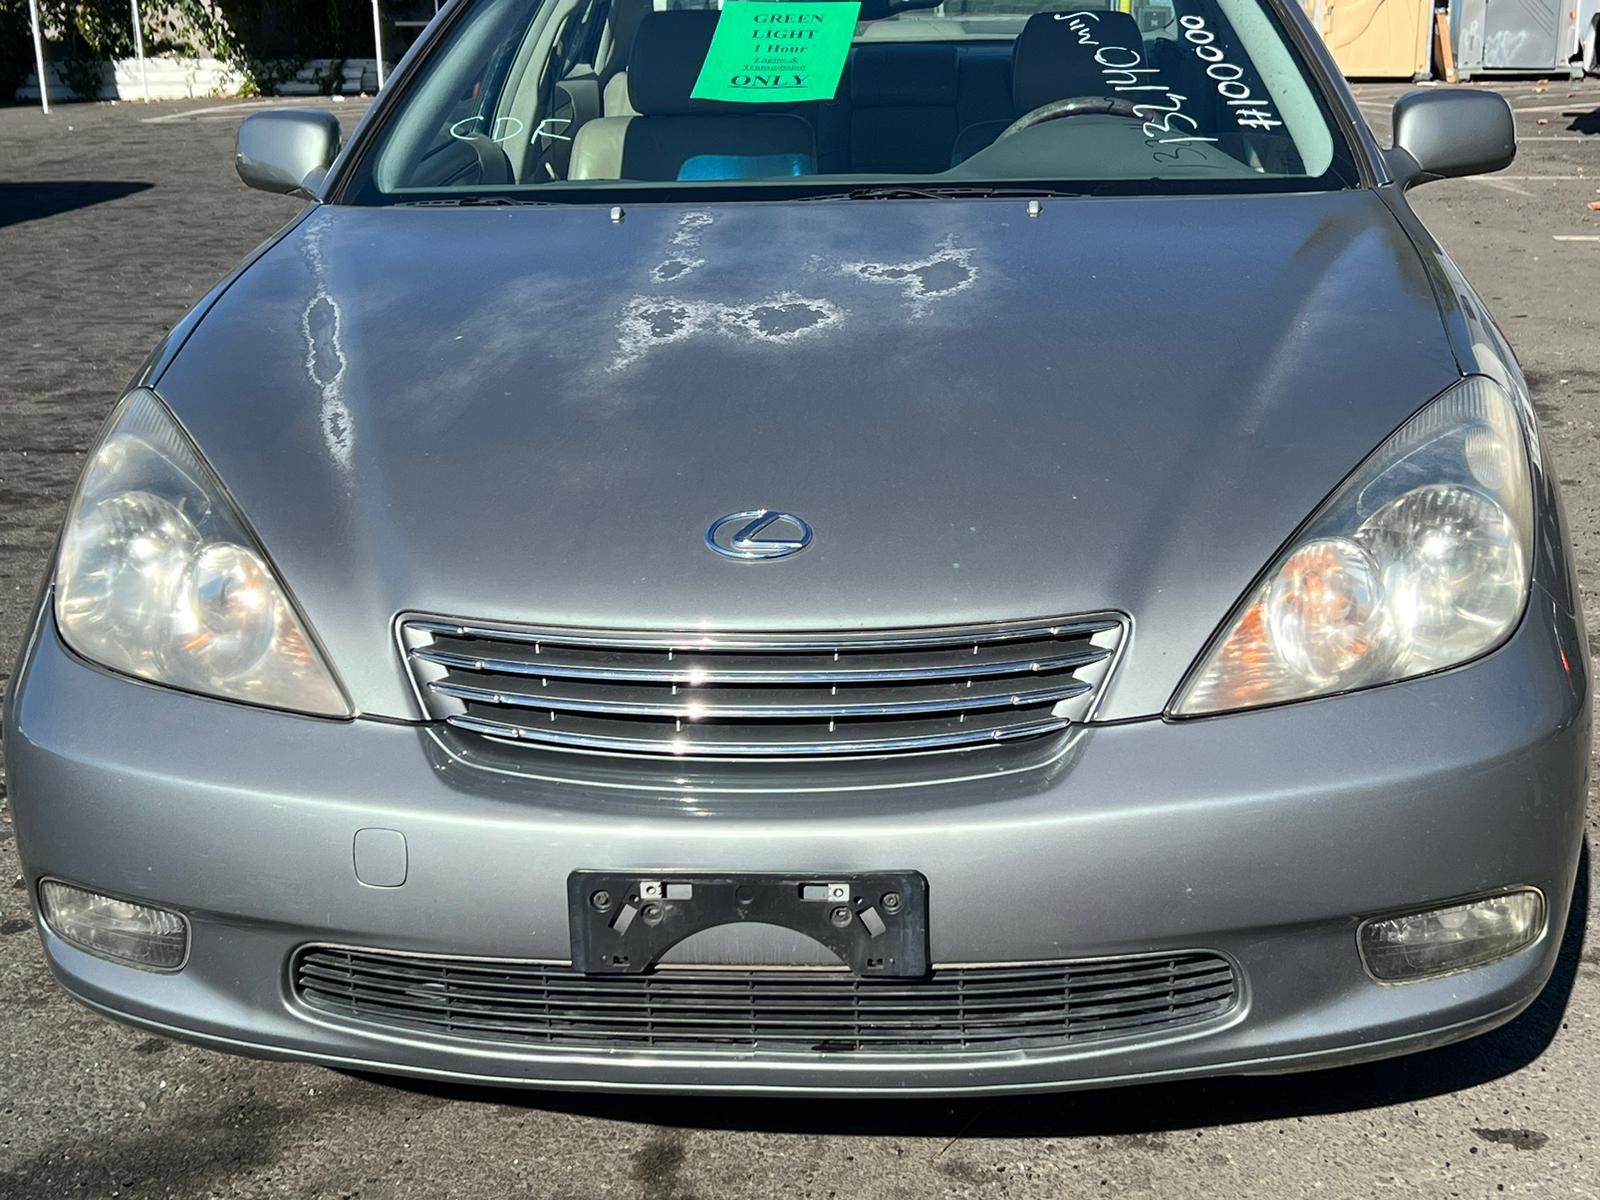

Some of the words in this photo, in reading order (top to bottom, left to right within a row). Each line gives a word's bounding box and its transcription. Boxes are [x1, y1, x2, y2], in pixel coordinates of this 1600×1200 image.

[753, 14, 825, 24] GREEN
[752, 30, 819, 39] LIGHT
[754, 45, 760, 53] 1
[767, 45, 809, 53] Hour
[730, 75, 811, 86] ONLY
